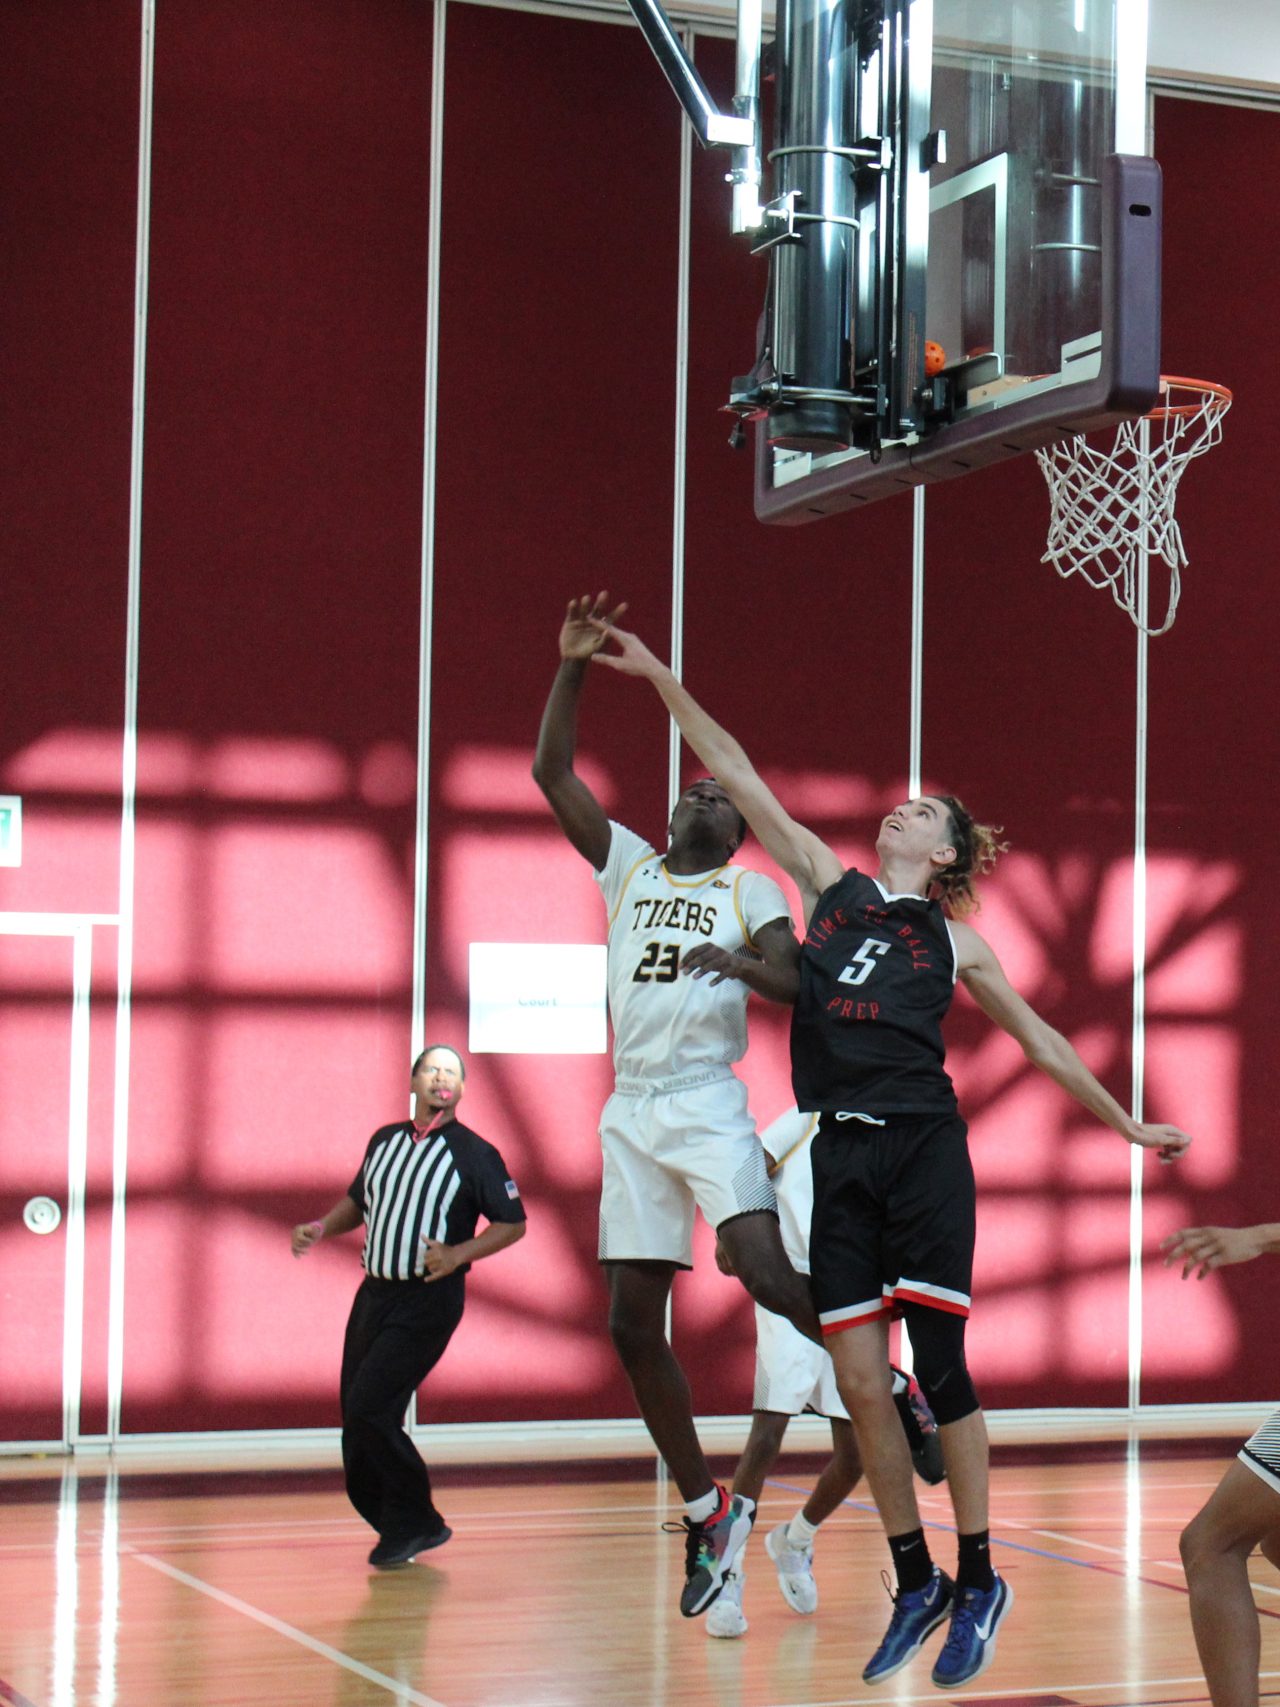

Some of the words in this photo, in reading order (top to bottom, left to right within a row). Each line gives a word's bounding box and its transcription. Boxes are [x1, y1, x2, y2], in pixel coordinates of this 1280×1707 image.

[632, 941, 681, 983] 23
[805, 908, 847, 951] TIME
[898, 924, 931, 971] BALL
[837, 937, 892, 986] 5
[827, 996, 880, 1020] PREP
